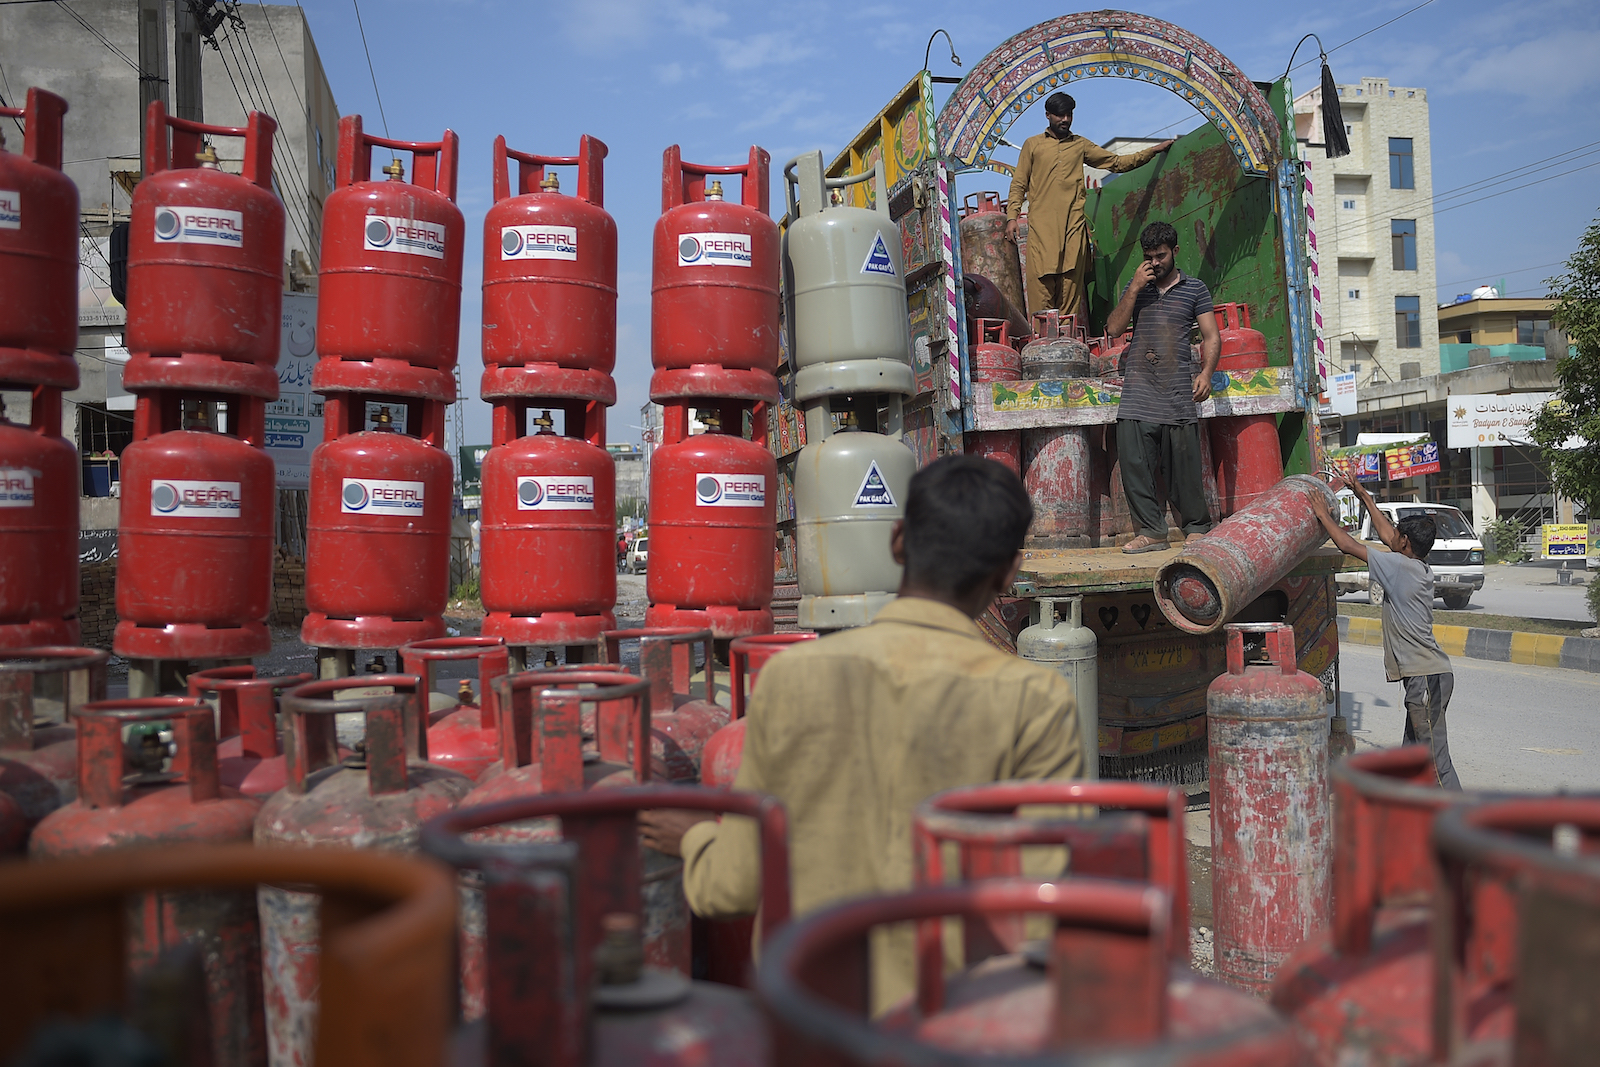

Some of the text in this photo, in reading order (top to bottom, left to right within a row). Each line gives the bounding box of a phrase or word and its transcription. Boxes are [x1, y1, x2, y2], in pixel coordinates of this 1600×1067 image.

[185, 215, 243, 231] PEARL
[219, 232, 241, 241] GAS
[396, 226, 444, 244] PEARL
[527, 234, 577, 245] PEARL
[426, 243, 444, 252] GAS
[556, 245, 577, 253] GAS
[704, 241, 751, 253] PEARL
[733, 253, 751, 261] GAS
[1472, 418, 1500, 429] Badyan
[547, 484, 594, 495] PEARL
[724, 482, 765, 493] PEARL
[184, 489, 241, 502] PEARL
[372, 488, 423, 501] PEARL
